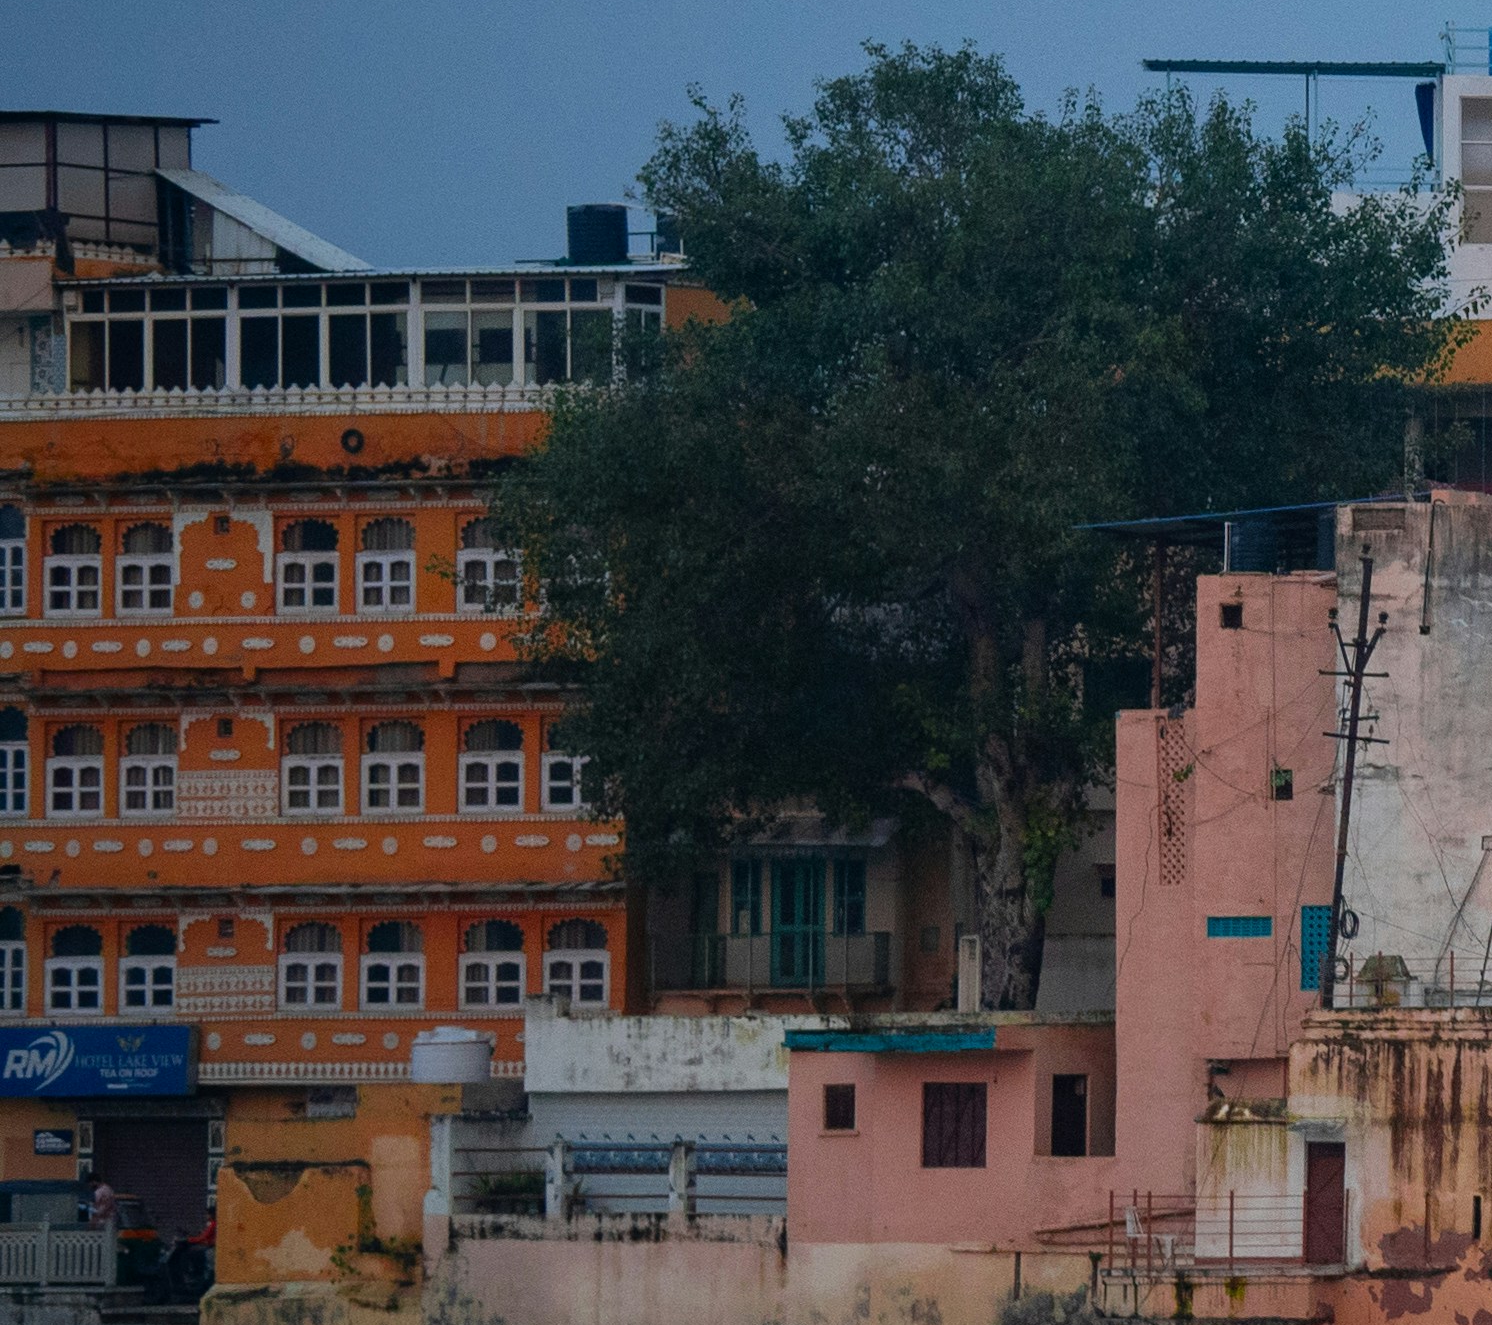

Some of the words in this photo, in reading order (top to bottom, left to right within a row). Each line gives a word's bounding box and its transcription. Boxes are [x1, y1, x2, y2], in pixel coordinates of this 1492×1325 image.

[3, 1049, 57, 1079] RM
[75, 1055, 114, 1068] HOTEL
[118, 1055, 148, 1068] LAKE
[151, 1054, 184, 1068] VIEW
[99, 1068, 118, 1078] TEA
[118, 1068, 133, 1078] ON
[134, 1067, 159, 1078] ROOF
